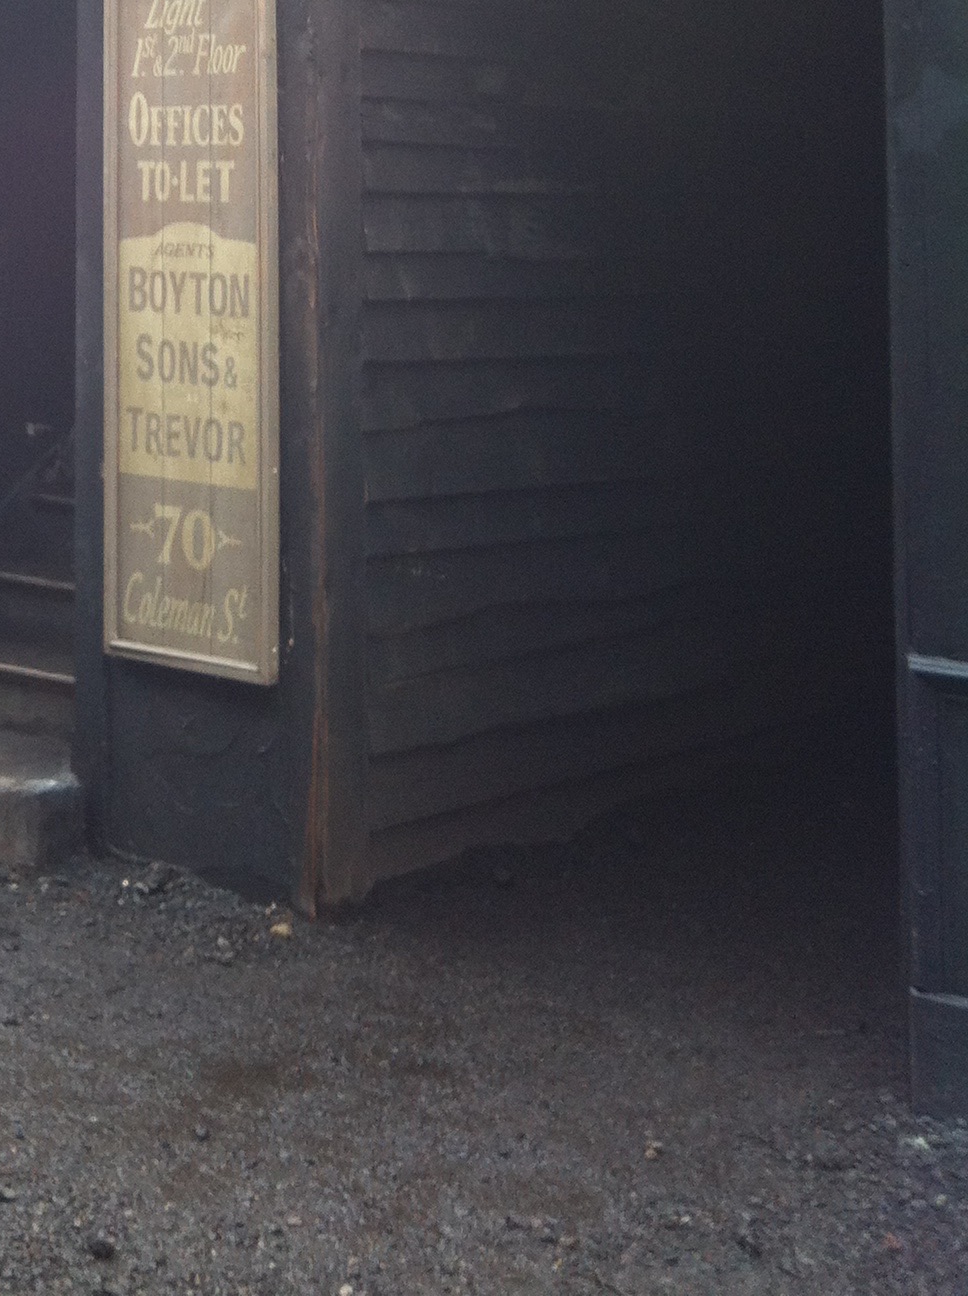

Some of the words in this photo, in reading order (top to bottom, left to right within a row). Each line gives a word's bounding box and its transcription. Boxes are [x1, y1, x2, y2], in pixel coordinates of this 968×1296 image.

[192, 33, 247, 77] Floor
[128, 91, 244, 147] OFFICES
[128, 266, 250, 318] BOYTON
[136, 332, 220, 387] SONS
[224, 356, 238, 389] &
[127, 405, 246, 466] TREVOR
[154, 502, 226, 572] 70
